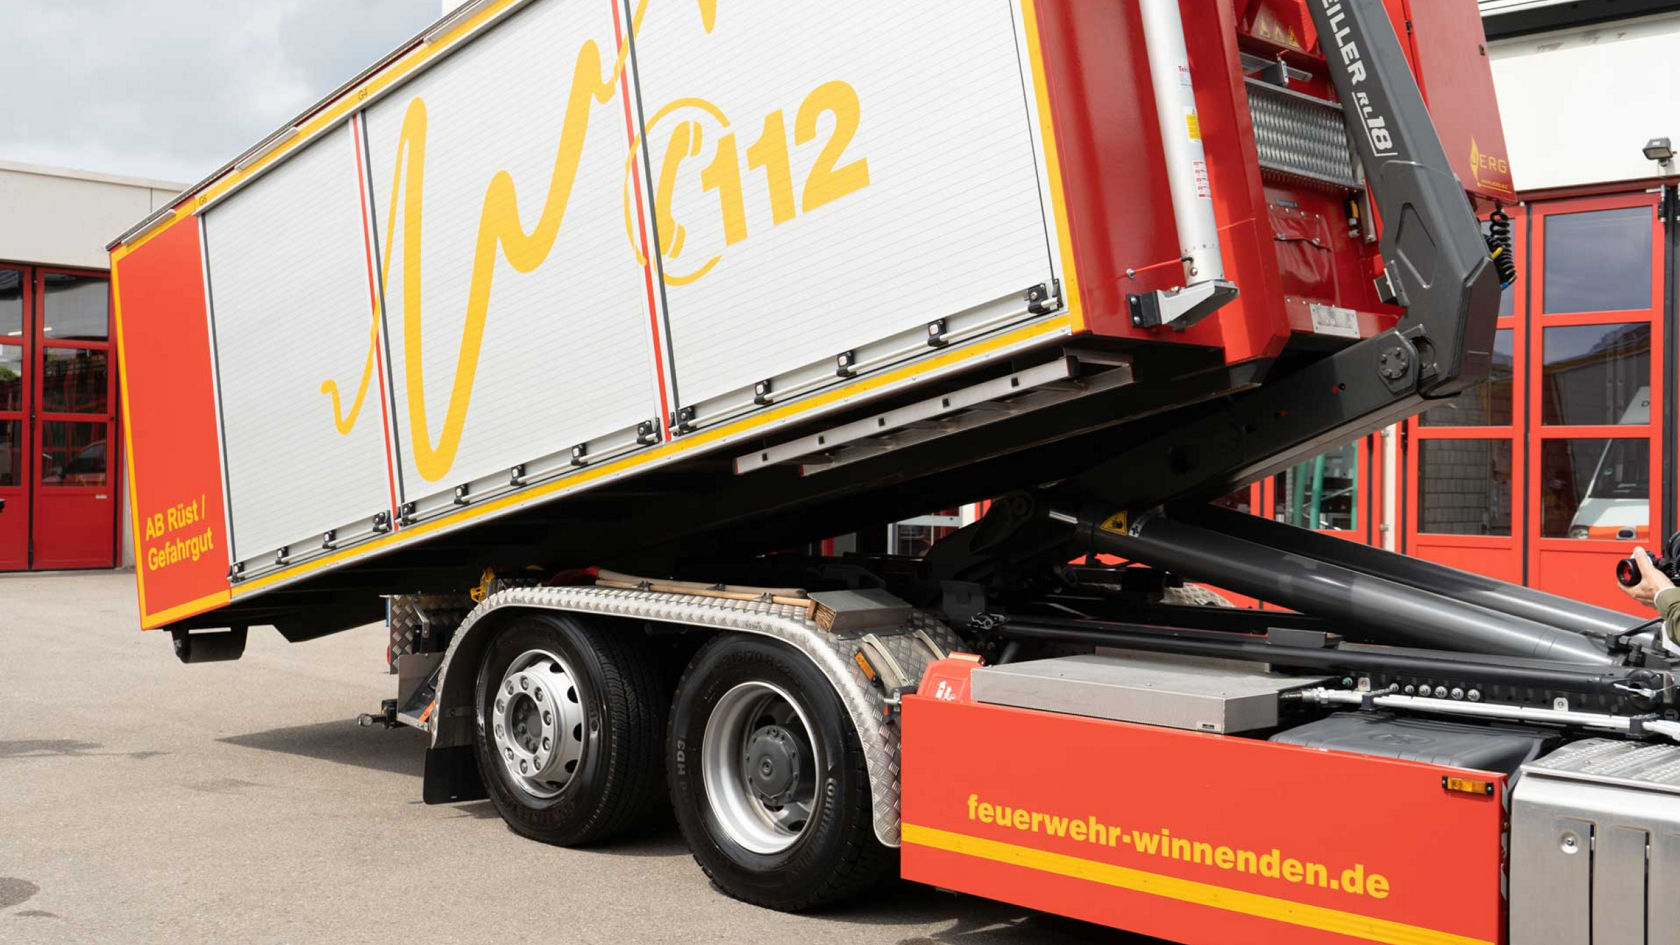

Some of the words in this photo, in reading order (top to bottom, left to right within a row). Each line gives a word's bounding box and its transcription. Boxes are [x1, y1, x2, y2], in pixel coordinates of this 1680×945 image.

[1356, 92, 1393, 150] RL18
[701, 80, 870, 247] 112
[146, 513, 165, 541] AB
[167, 499, 199, 532] Rüst
[147, 526, 214, 571] Gefahrgut
[967, 794, 1390, 899] feuerwehr-winnenden.de
